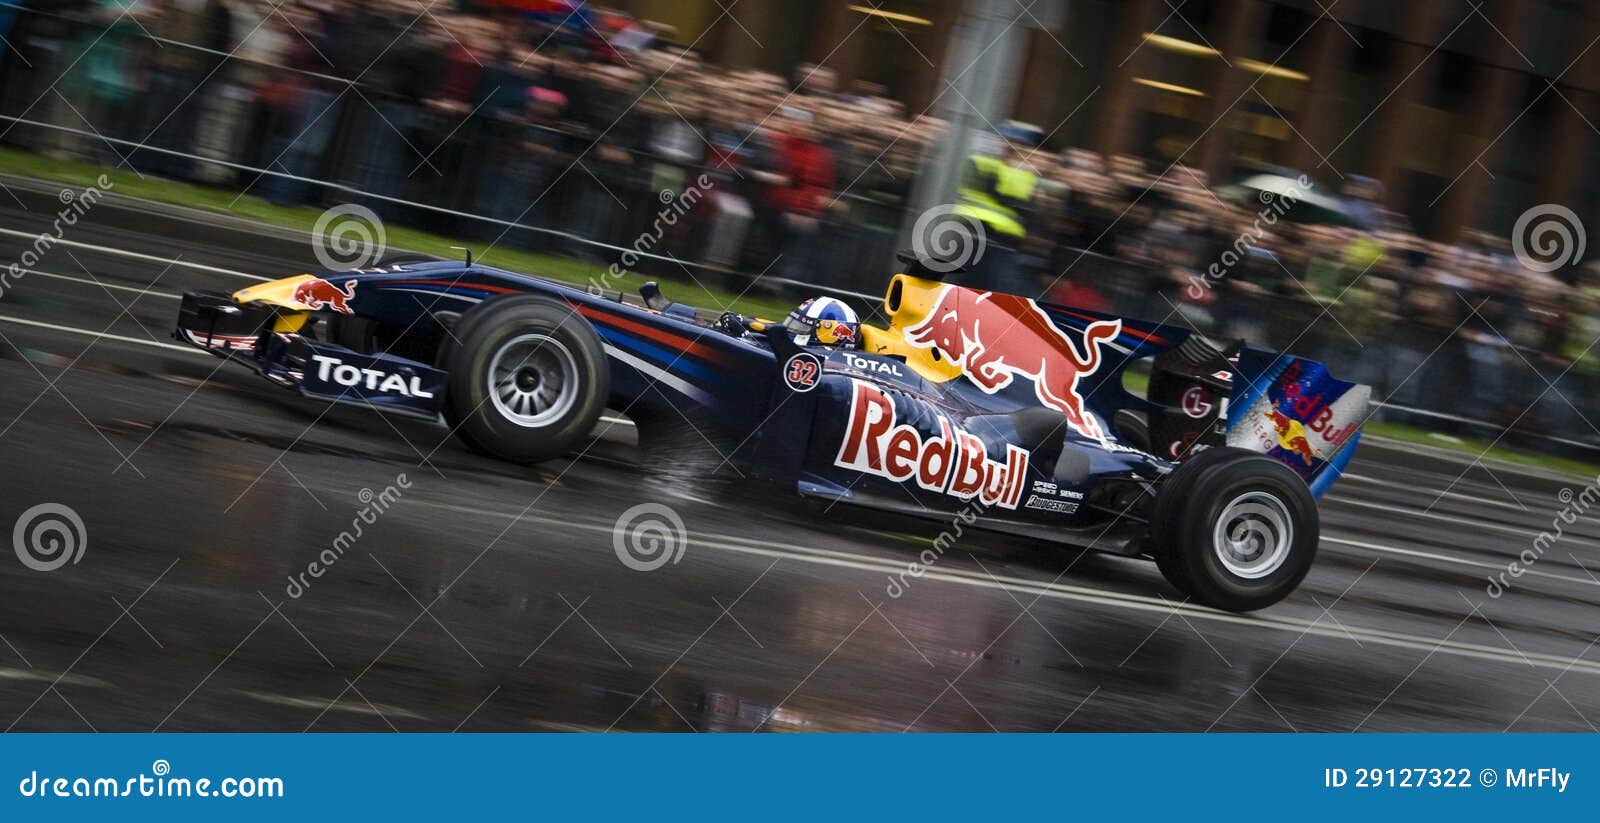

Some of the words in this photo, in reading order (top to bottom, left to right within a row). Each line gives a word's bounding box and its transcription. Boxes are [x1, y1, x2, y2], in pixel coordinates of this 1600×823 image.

[312, 354, 434, 398] TOTAL
[788, 359, 817, 386] 32
[843, 353, 903, 377] TOTAL
[1307, 404, 1359, 446] Bull
[834, 379, 955, 493] Red
[947, 426, 1030, 511] Bull
[1025, 494, 1080, 514] BRIDGESTONE
